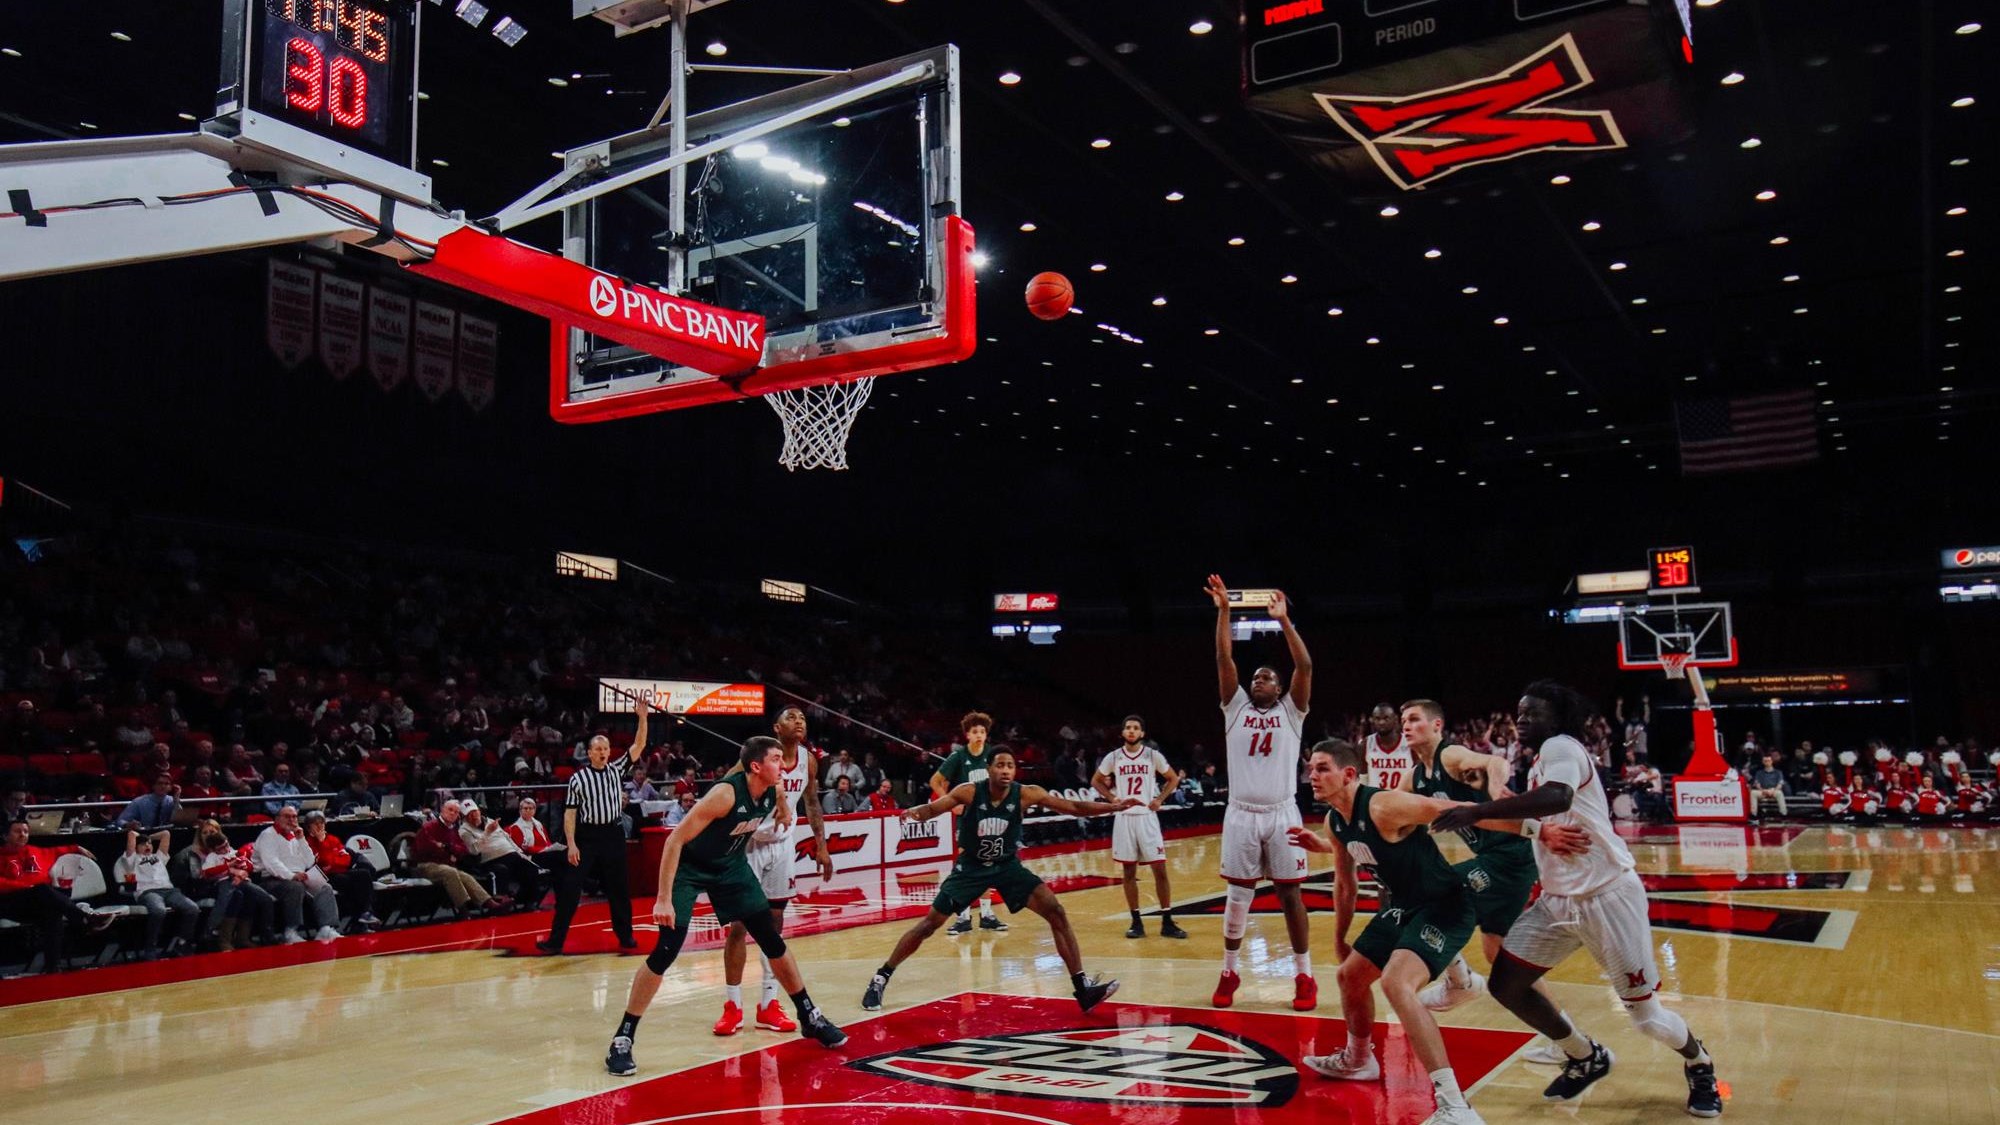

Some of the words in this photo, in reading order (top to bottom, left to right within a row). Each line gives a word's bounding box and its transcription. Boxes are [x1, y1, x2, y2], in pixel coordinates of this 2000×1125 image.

[1375, 18, 1437, 46] PERIOD
[285, 37, 367, 128] 30
[1657, 550, 1689, 563] 11:45
[1658, 564, 1688, 585] 30
[691, 684, 705, 692] Now
[1243, 715, 1281, 730] MIAMI
[1248, 732, 1274, 757] 14
[1119, 764, 1149, 775] MIAMI
[1371, 757, 1407, 769] MIAMI
[783, 778, 803, 792] AMI
[1127, 777, 1143, 795] 12
[1379, 771, 1401, 788] 30
[1680, 793, 1737, 805] Frontier
[977, 838, 1004, 860] 23
[1296, 859, 1305, 870] M
[1624, 968, 1648, 990] M
